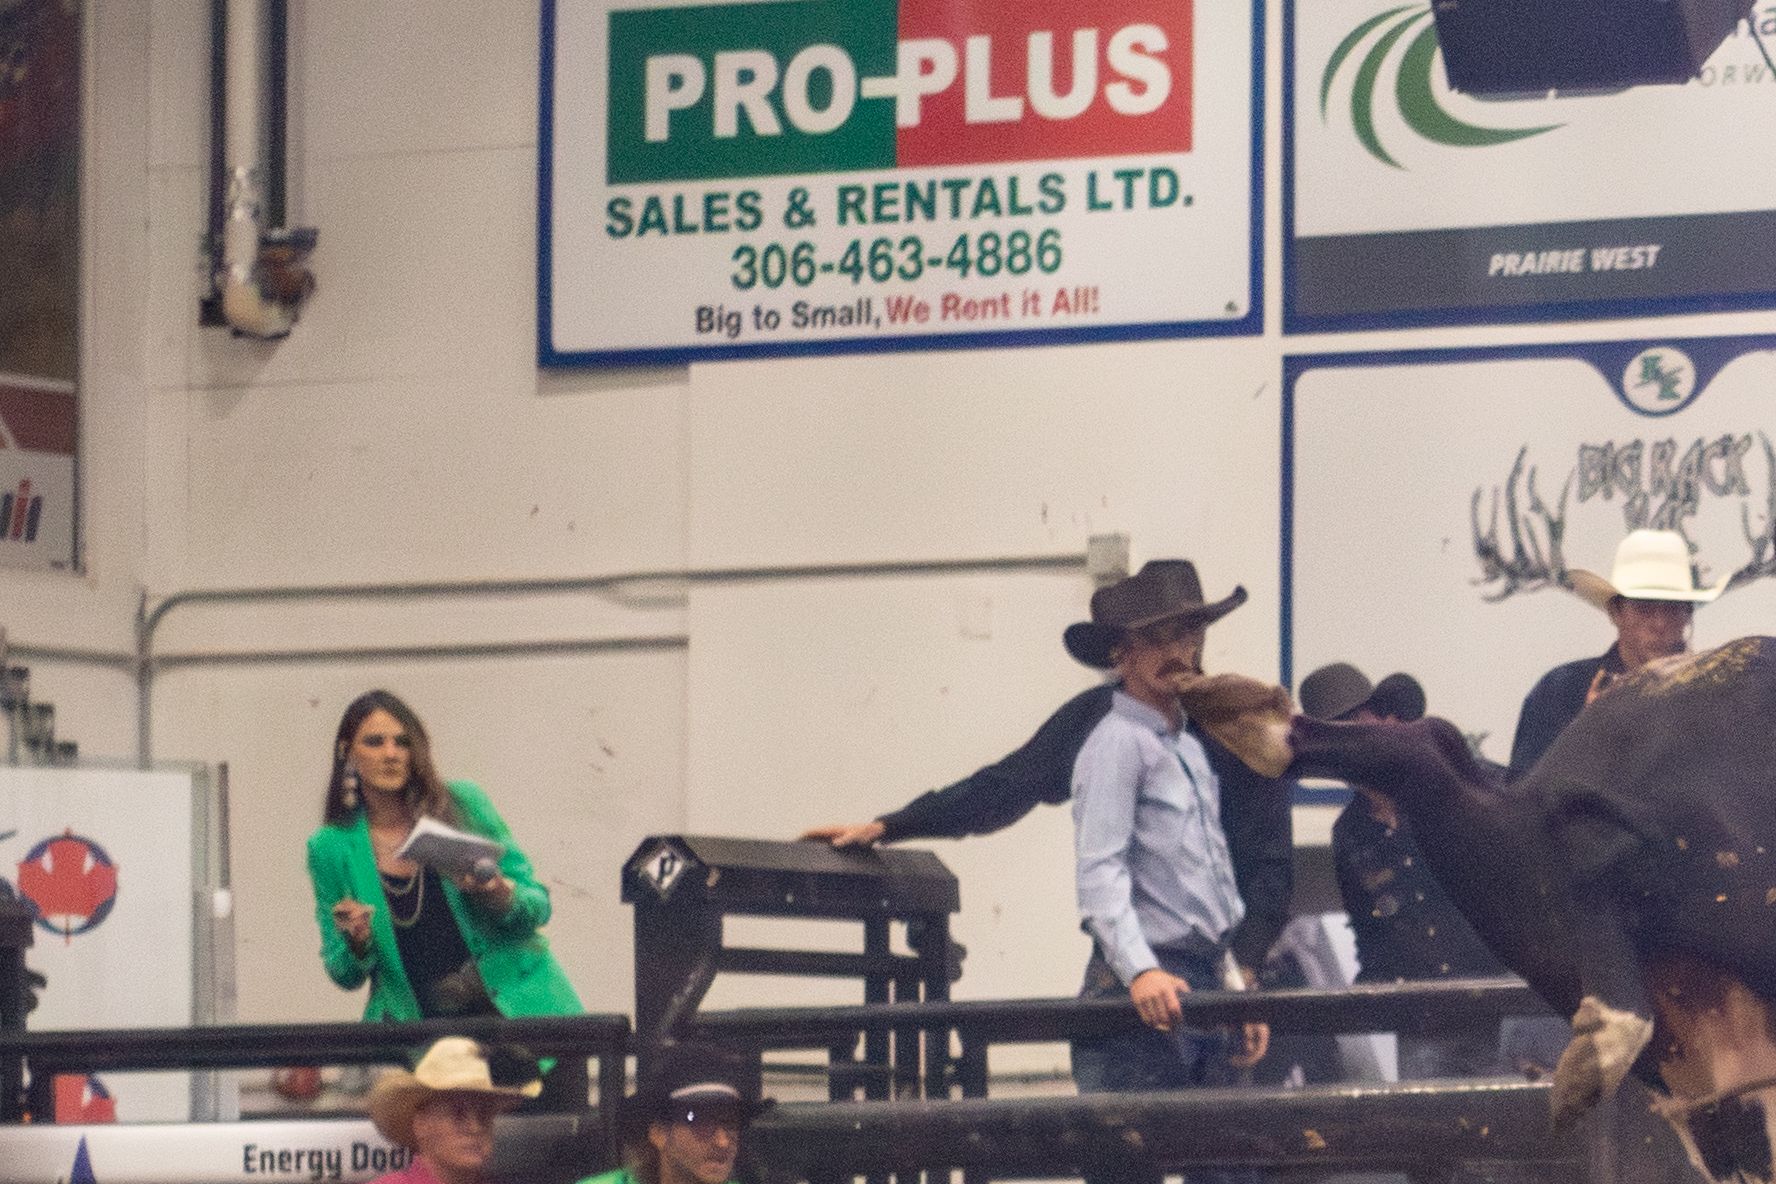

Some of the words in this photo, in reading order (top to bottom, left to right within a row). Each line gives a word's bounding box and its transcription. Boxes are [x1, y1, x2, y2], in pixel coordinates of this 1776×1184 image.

[644, 23, 1172, 143] PRO-PLUS
[605, 190, 763, 240] SALES
[783, 187, 816, 227] &
[838, 172, 1067, 227] RENTALS
[1087, 166, 1194, 212] LTD.
[731, 227, 1063, 292] 306-463-4886
[1488, 248, 1587, 277] PRAIRIE
[1591, 245, 1663, 272] WEST
[695, 305, 742, 338] Big
[753, 303, 781, 332] to
[791, 297, 881, 330] Small,
[885, 295, 930, 323] We
[941, 291, 1010, 321] Rent
[243, 1142, 342, 1181] Energy
[352, 1142, 413, 1172] Dod
